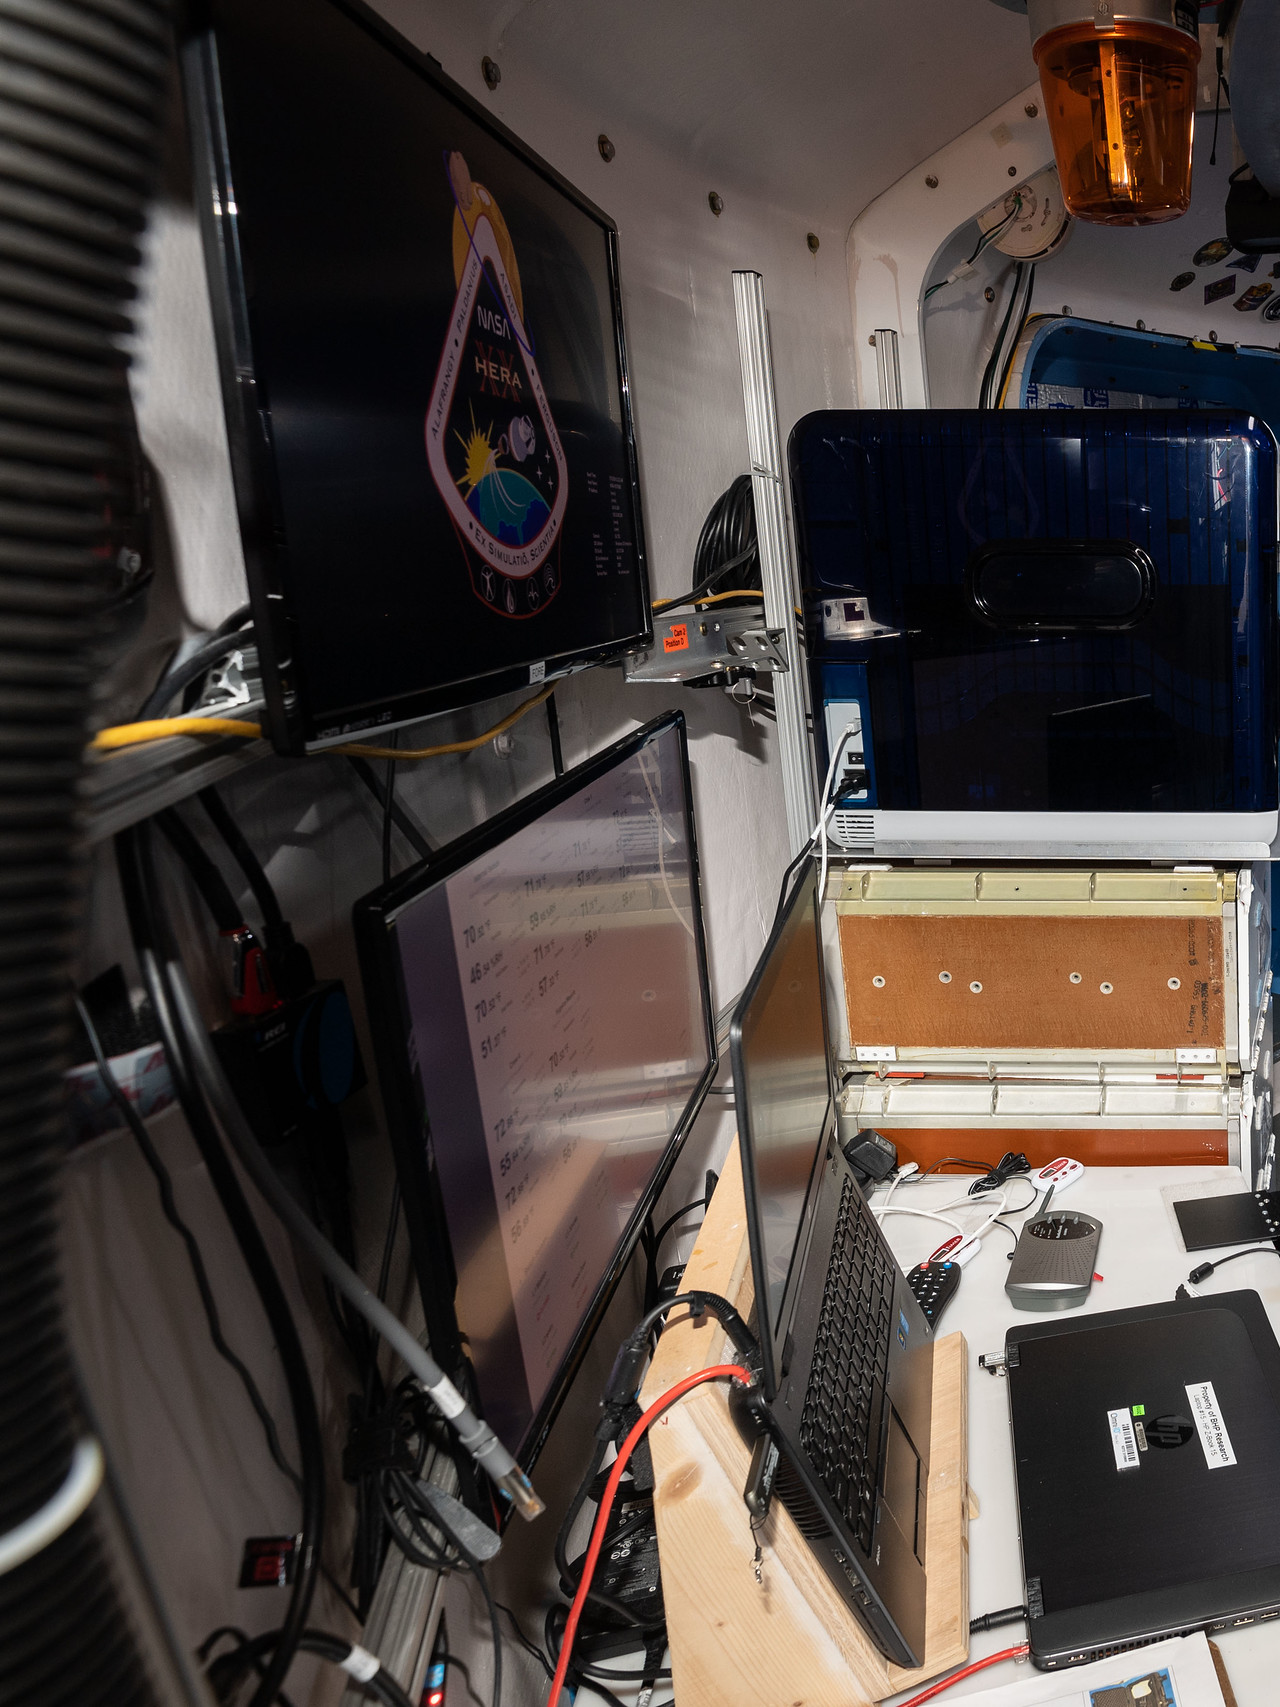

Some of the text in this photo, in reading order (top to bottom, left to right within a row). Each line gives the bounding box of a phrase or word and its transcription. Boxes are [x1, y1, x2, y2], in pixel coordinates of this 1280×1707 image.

[457, 259, 478, 334] PALDANIUS
[477, 305, 512, 340] NASA
[474, 356, 523, 389] HERA
[433, 350, 456, 440] ALAFRANGY
[666, 639, 680, 648] Position
[1200, 1386, 1212, 1410] Property
[1210, 1418, 1220, 1431] BHP
[1214, 1432, 1229, 1462] Research
